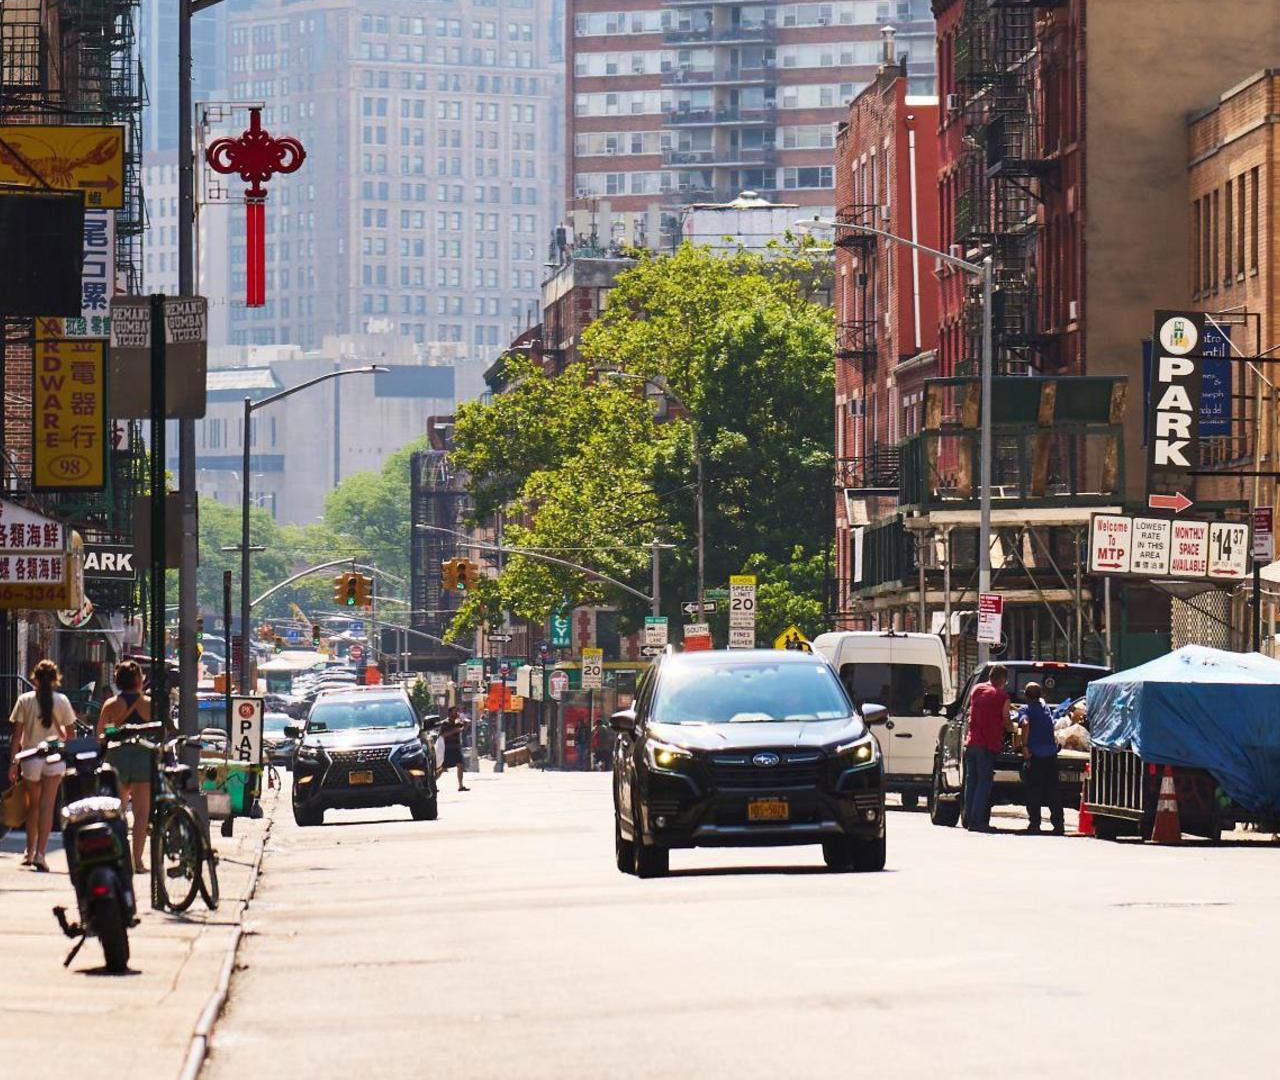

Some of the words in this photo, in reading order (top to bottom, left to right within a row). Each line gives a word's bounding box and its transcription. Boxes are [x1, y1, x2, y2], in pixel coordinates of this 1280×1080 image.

[40, 318, 66, 448] ARDWARE
[1154, 356, 1195, 466] PARK
[60, 460, 81, 475] 98
[1096, 520, 1128, 533] Welcome
[1135, 521, 1167, 532] LOWEST
[1175, 526, 1204, 540] MONTHLY
[1108, 534, 1116, 547] To
[1141, 532, 1161, 540] RATE
[1233, 529, 1244, 545] 37
[1137, 541, 1145, 549] IN
[1147, 541, 1164, 550] THIS
[1179, 543, 1200, 556] SPACE
[1097, 548, 1125, 560] MTP
[1139, 551, 1160, 559] AREA
[83, 553, 134, 572] ARK
[1172, 558, 1206, 572] AVAILABLE
[732, 598, 753, 610] 20
[686, 626, 708, 634] SOUTH
[584, 665, 601, 676] 20
[239, 719, 252, 762] PAR
